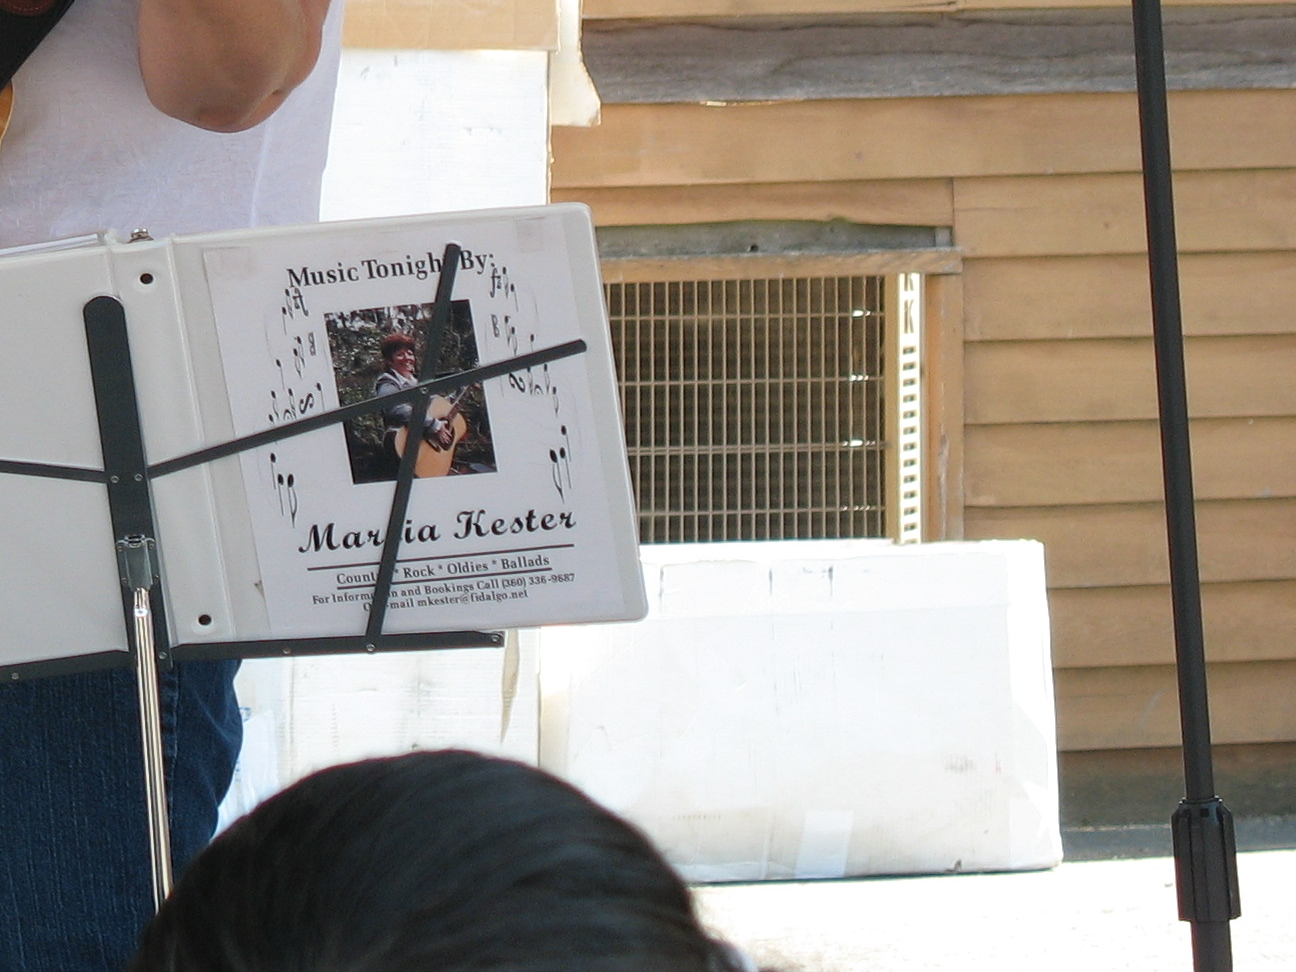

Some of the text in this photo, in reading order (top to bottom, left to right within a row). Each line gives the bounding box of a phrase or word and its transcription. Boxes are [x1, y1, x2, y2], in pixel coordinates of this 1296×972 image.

[287, 249, 495, 288] Music Tonigh By:
[299, 508, 576, 553] Maria Kester
[336, 554, 550, 585] Count Rock Oldies Ballads
[312, 594, 331, 605] For
[401, 584, 422, 597] and
[424, 582, 475, 595] Bookings
[476, 578, 500, 591] Call
[385, 598, 415, 609] -mail
